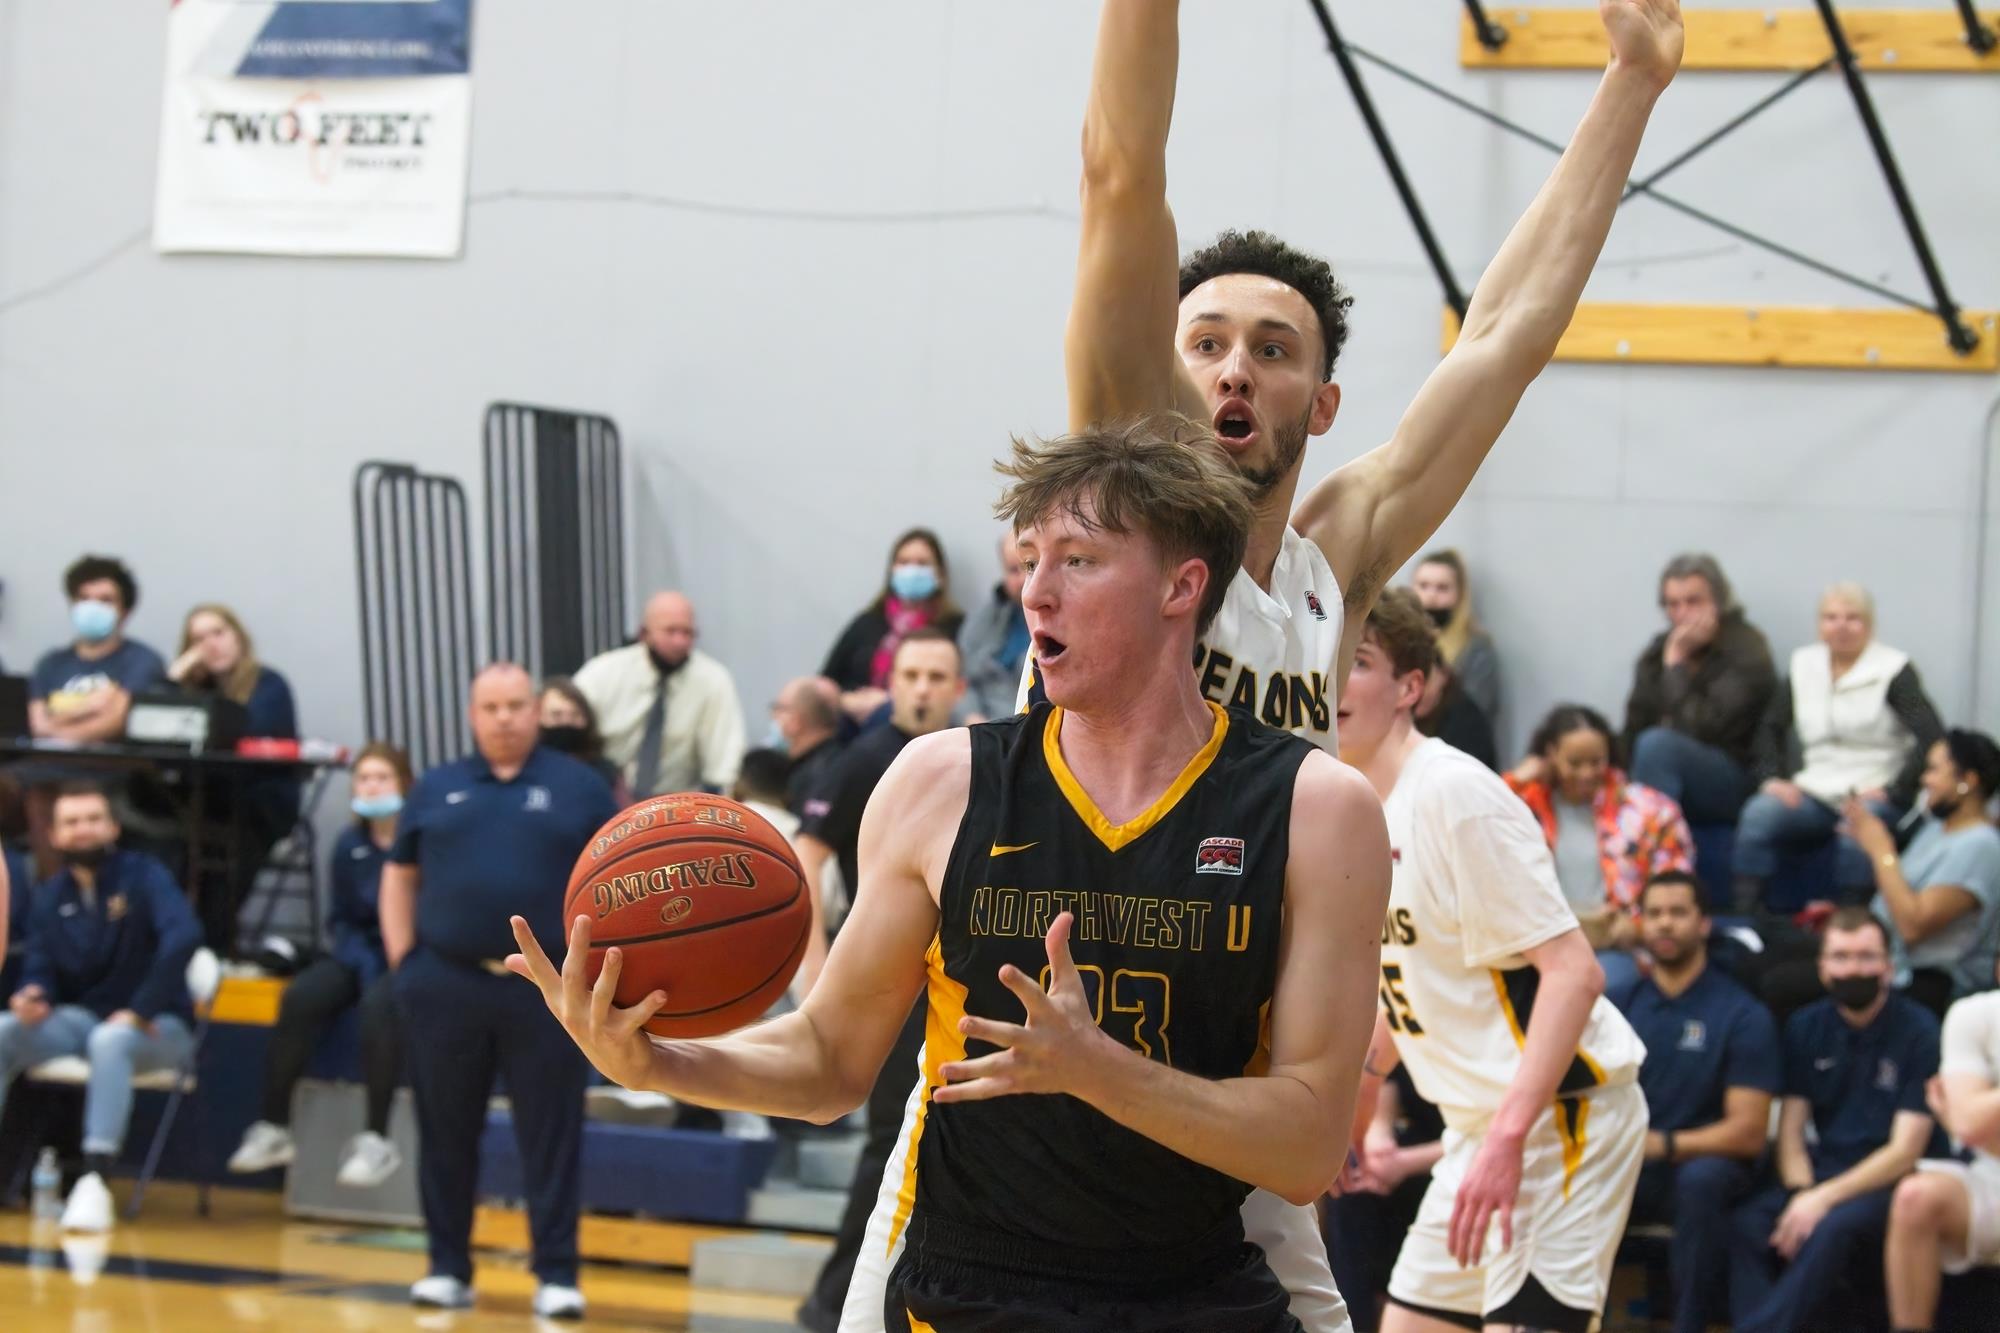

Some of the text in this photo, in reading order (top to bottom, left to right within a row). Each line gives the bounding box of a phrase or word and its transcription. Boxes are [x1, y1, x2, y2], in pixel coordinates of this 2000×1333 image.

[200, 111, 430, 145] TWO FEET
[1200, 838, 1243, 848] CASCADE
[592, 852, 757, 919] SPALDING
[970, 886, 1252, 952] NORTHWEST U
